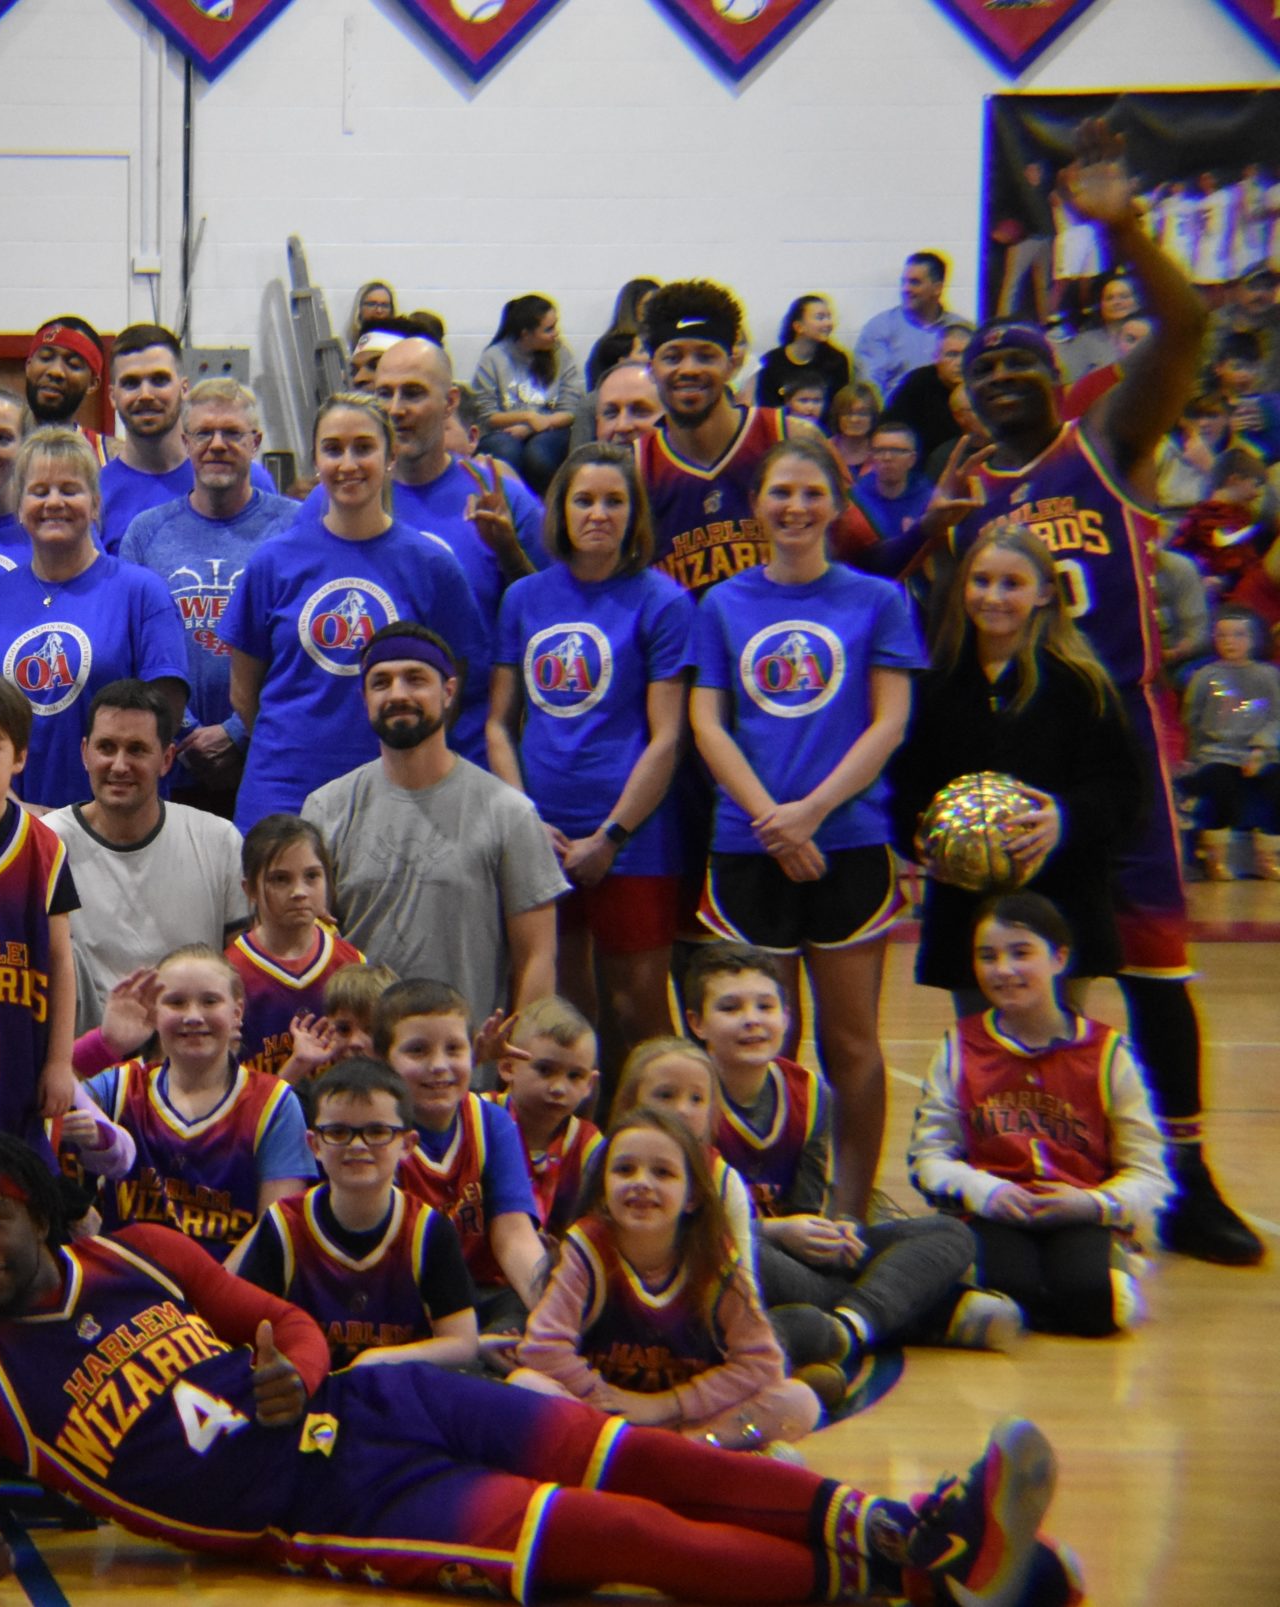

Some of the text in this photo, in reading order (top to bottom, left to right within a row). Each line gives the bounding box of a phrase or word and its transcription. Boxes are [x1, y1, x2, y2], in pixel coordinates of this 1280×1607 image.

[672, 520, 766, 558] HARLE
[311, 613, 375, 650] OA
[15, 653, 75, 691] OA
[533, 654, 593, 692] OA
[753, 653, 826, 693] OA
[63, 1301, 188, 1408] HARLEM
[55, 1314, 232, 1480] WIZARDS
[172, 1378, 250, 1455] 4
